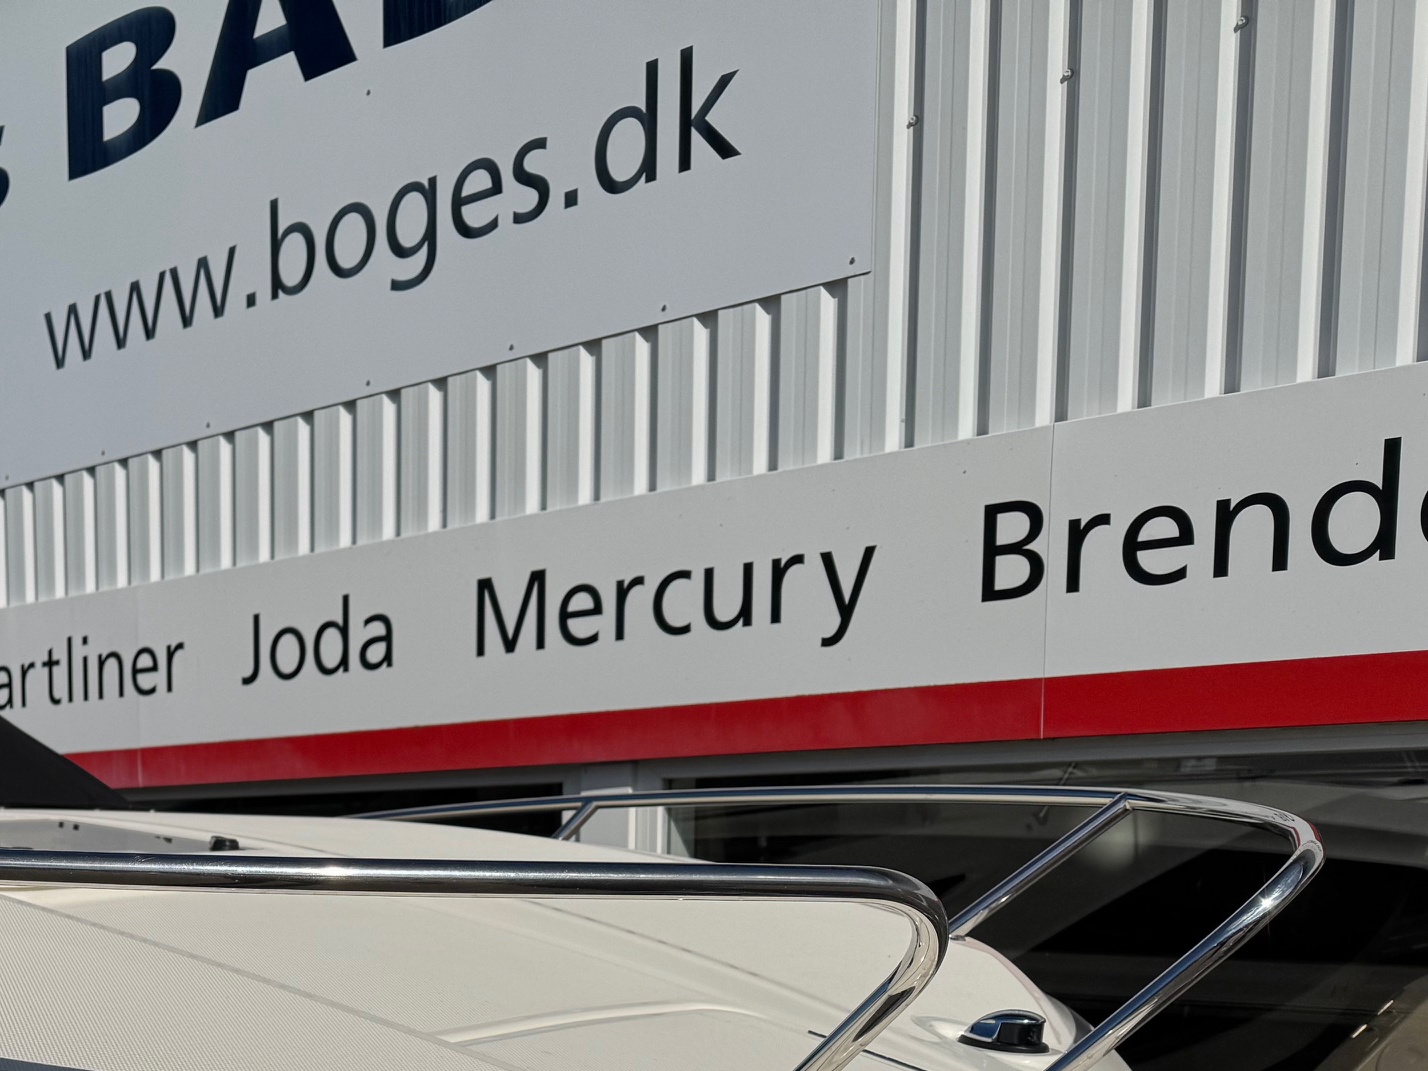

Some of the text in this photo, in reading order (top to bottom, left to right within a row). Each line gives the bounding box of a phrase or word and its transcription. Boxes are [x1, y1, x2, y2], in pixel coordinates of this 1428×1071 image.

[45, 46, 742, 370] www.boges.dk
[241, 593, 393, 686] Joda
[477, 545, 877, 657] Mercury
[981, 436, 1428, 602] Brend
